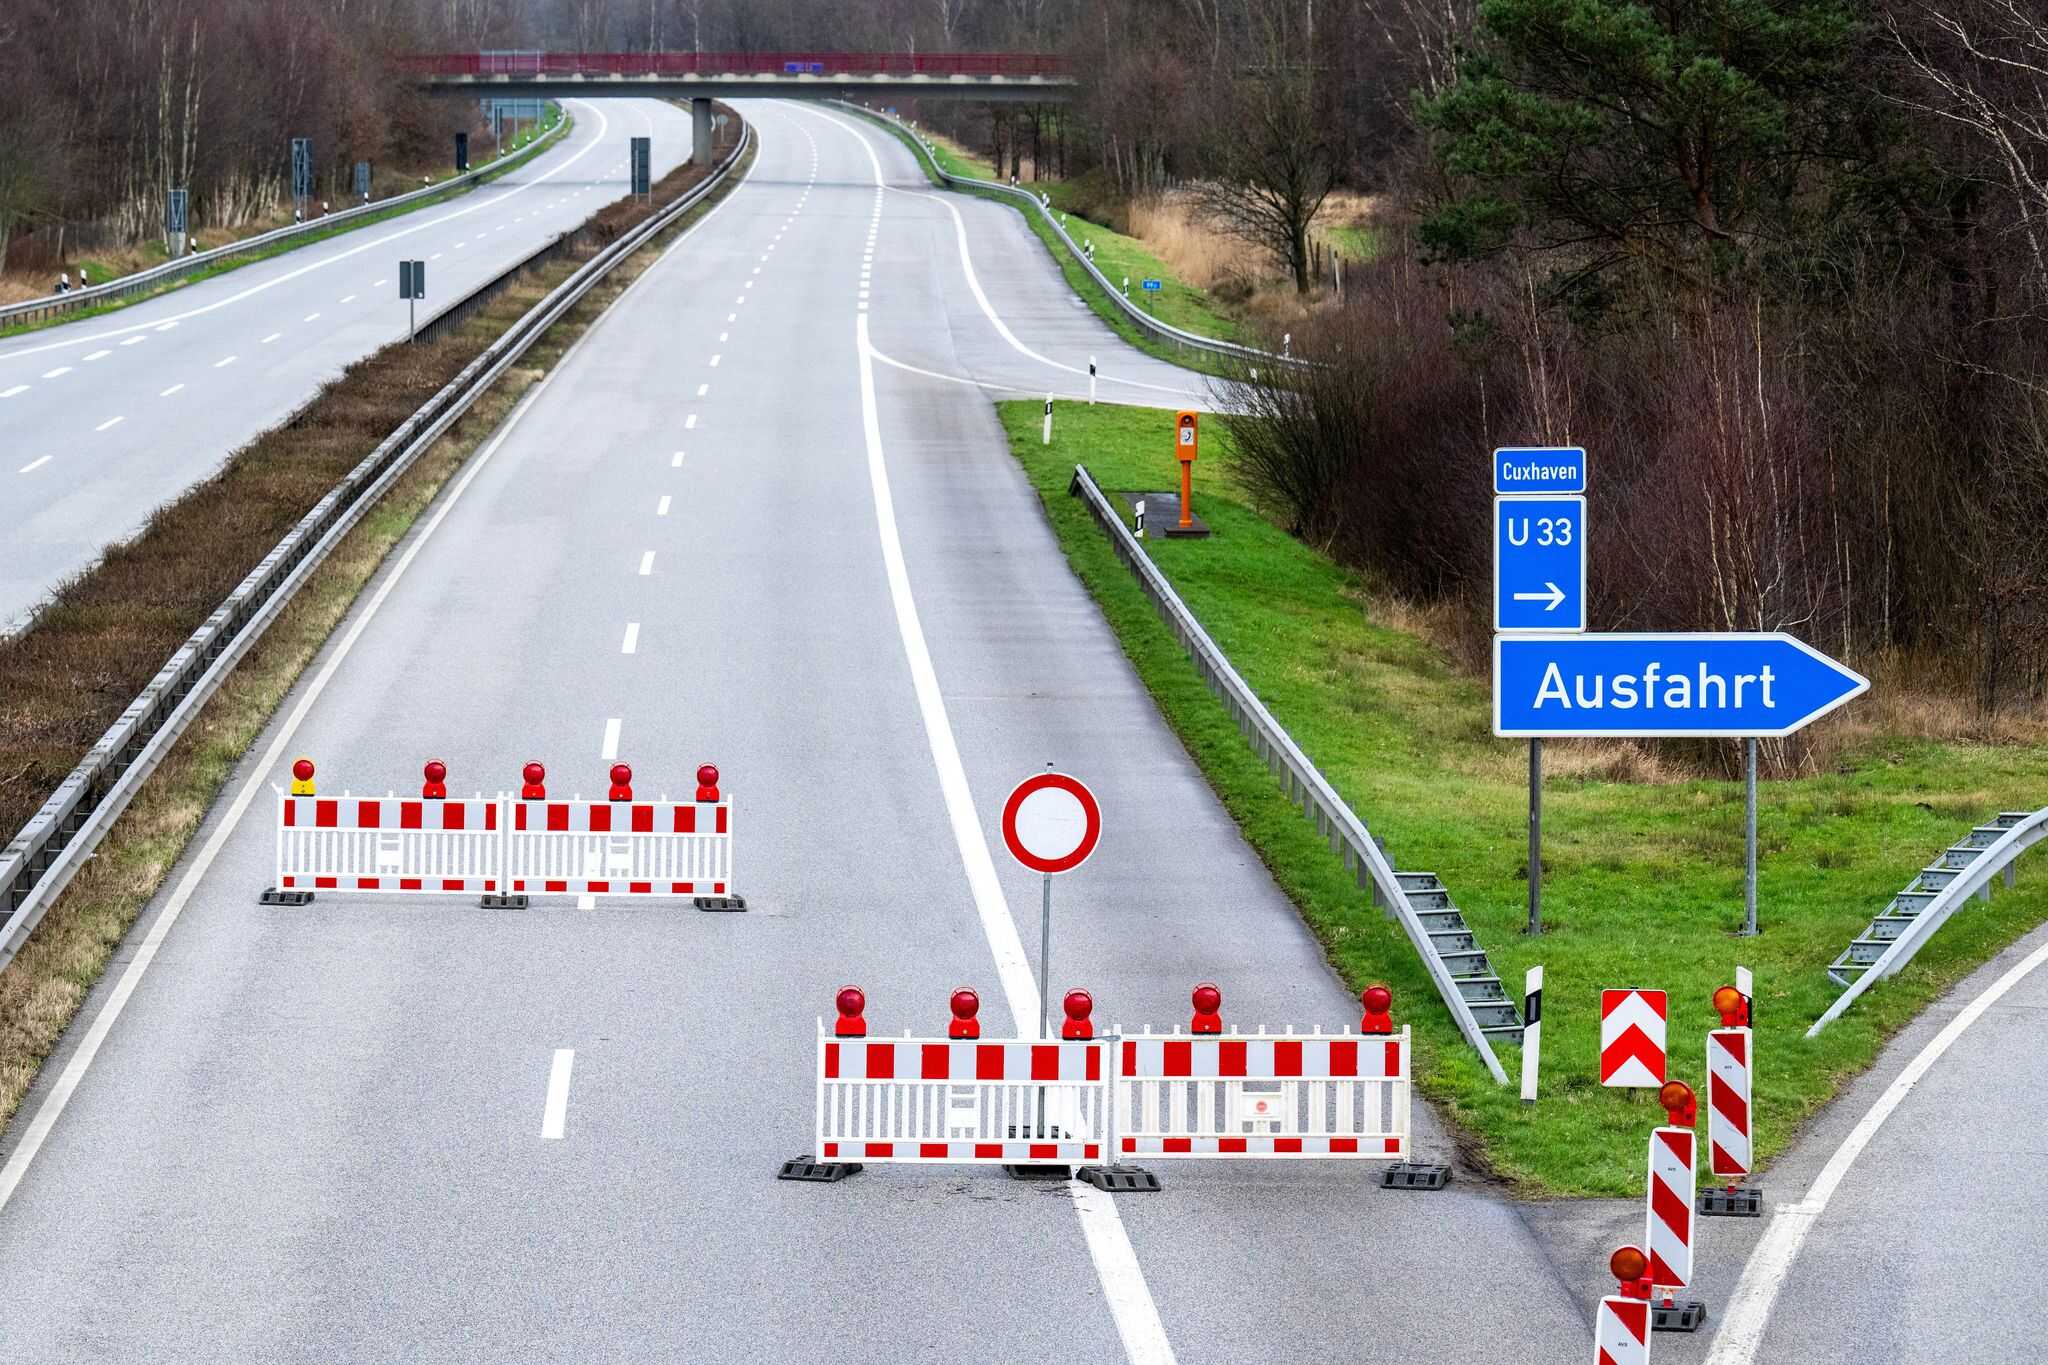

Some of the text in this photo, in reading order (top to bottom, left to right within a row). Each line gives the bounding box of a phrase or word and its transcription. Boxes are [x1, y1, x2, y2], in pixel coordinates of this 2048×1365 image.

[1503, 462, 1577, 481] Cuxhaven
[1508, 517, 1572, 546] U 33
[1533, 662, 1776, 709] Ausfahrt
